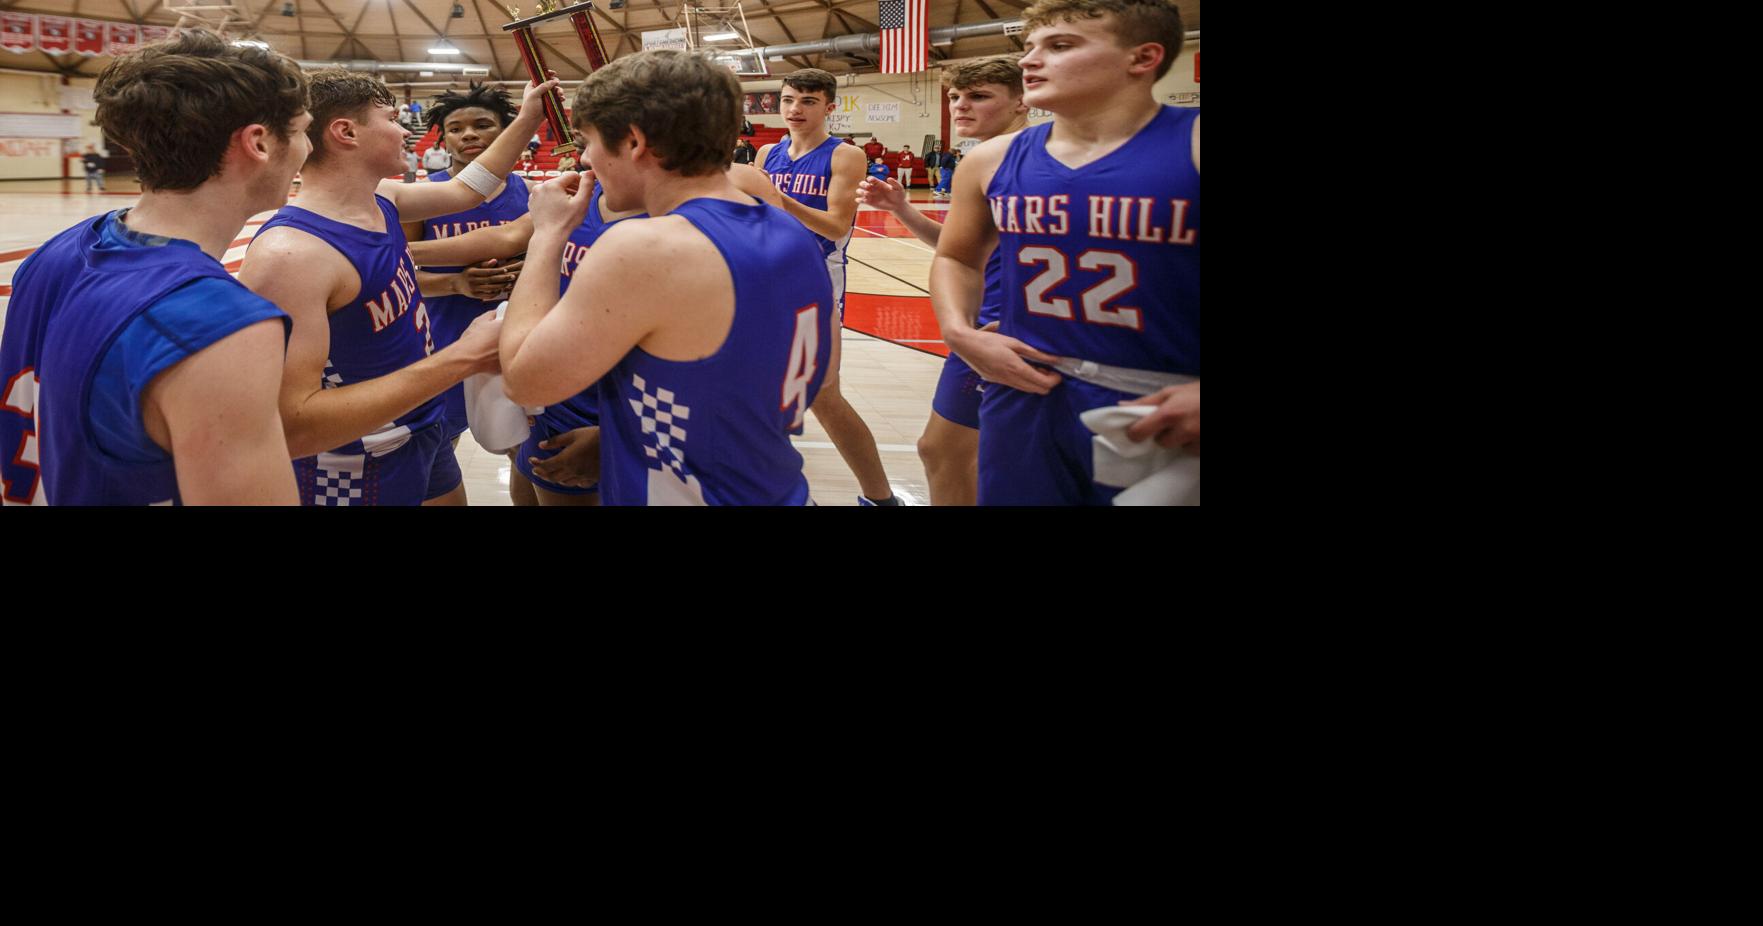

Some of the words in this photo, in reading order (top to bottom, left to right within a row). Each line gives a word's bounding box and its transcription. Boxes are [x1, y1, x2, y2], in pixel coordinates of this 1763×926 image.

[792, 173, 827, 196] HILL
[989, 194, 1070, 235] MARS
[1087, 195, 1197, 245] HILL
[366, 257, 415, 332] MARS
[1018, 245, 1144, 332] 22
[779, 302, 819, 433] 4
